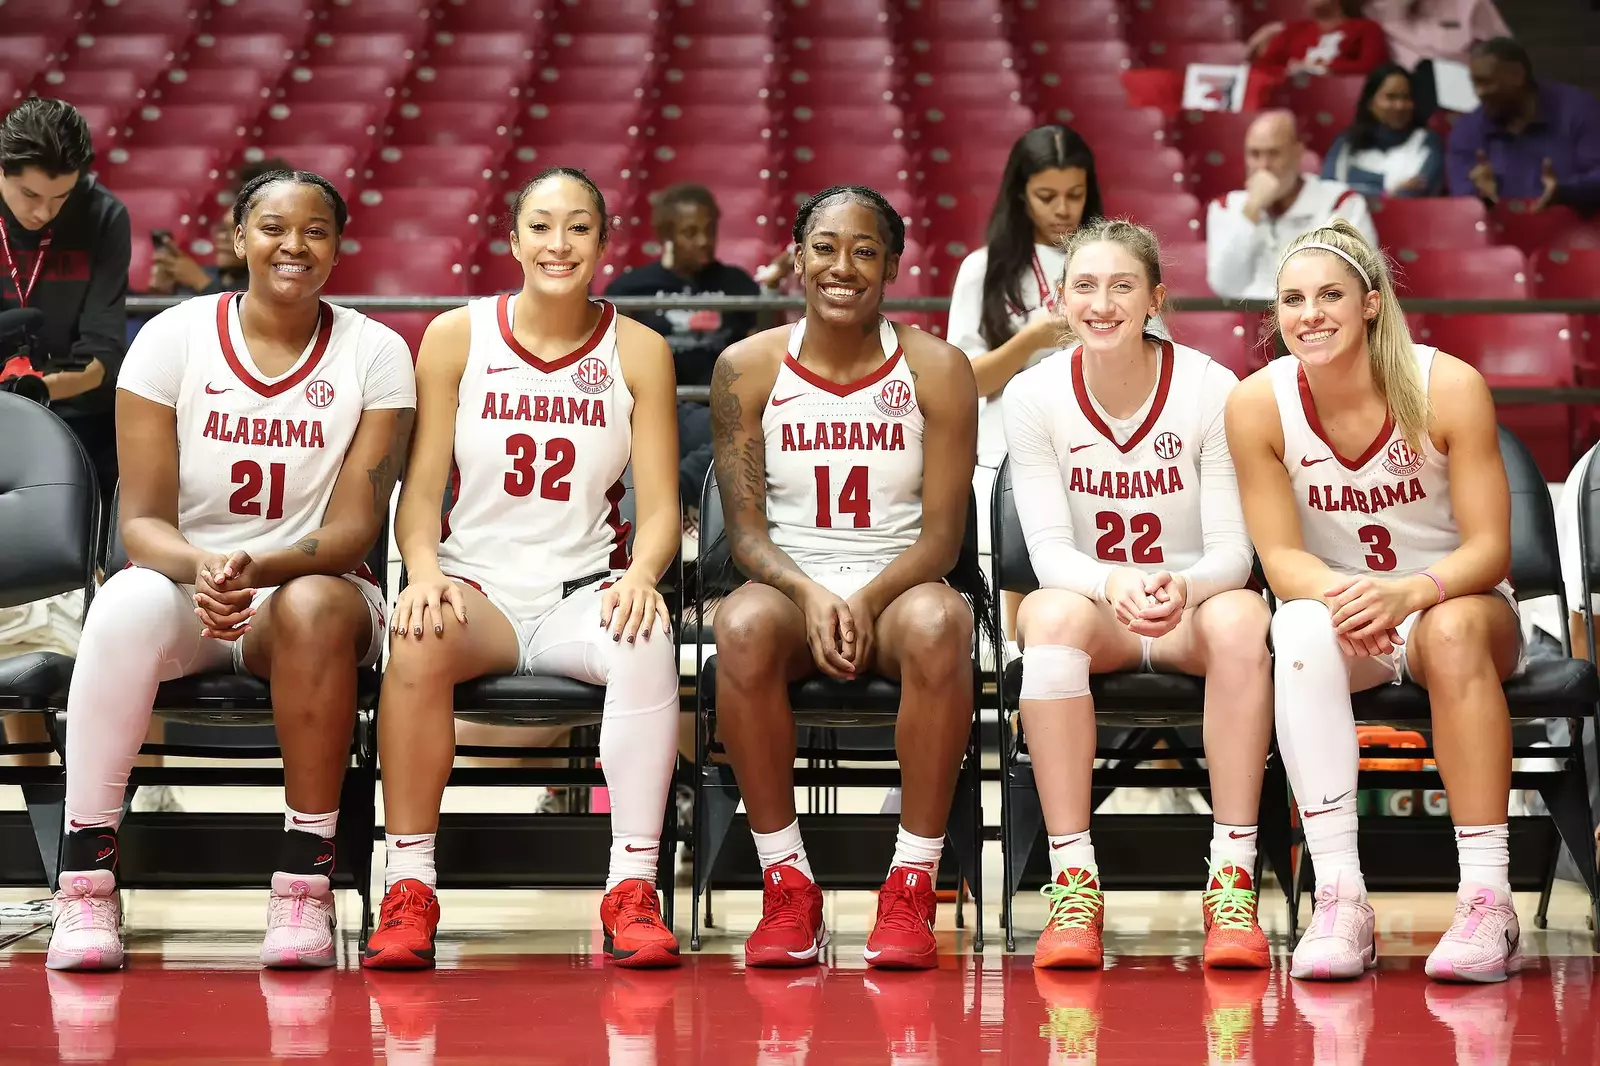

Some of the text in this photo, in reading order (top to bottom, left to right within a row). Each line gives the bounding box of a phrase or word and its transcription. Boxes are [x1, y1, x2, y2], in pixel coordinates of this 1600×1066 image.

[575, 380, 608, 393] GRADUATE
[579, 360, 606, 384] SEC
[307, 381, 333, 407] SEC
[482, 392, 606, 427] ALABAMA
[877, 402, 908, 416] GRADUATE
[883, 381, 910, 408] SEC
[204, 411, 325, 448] ALABAMA
[782, 423, 906, 451] ALABAMA
[1155, 433, 1181, 459] SEC
[504, 434, 576, 502] 32
[1070, 466, 1184, 499] ALABAMA
[1388, 461, 1422, 475] GRADUATE
[229, 460, 285, 520] 21
[815, 466, 870, 528] 14
[1308, 478, 1426, 514] ALABAMA
[1096, 511, 1163, 563] 22
[1358, 525, 1397, 571] 3
